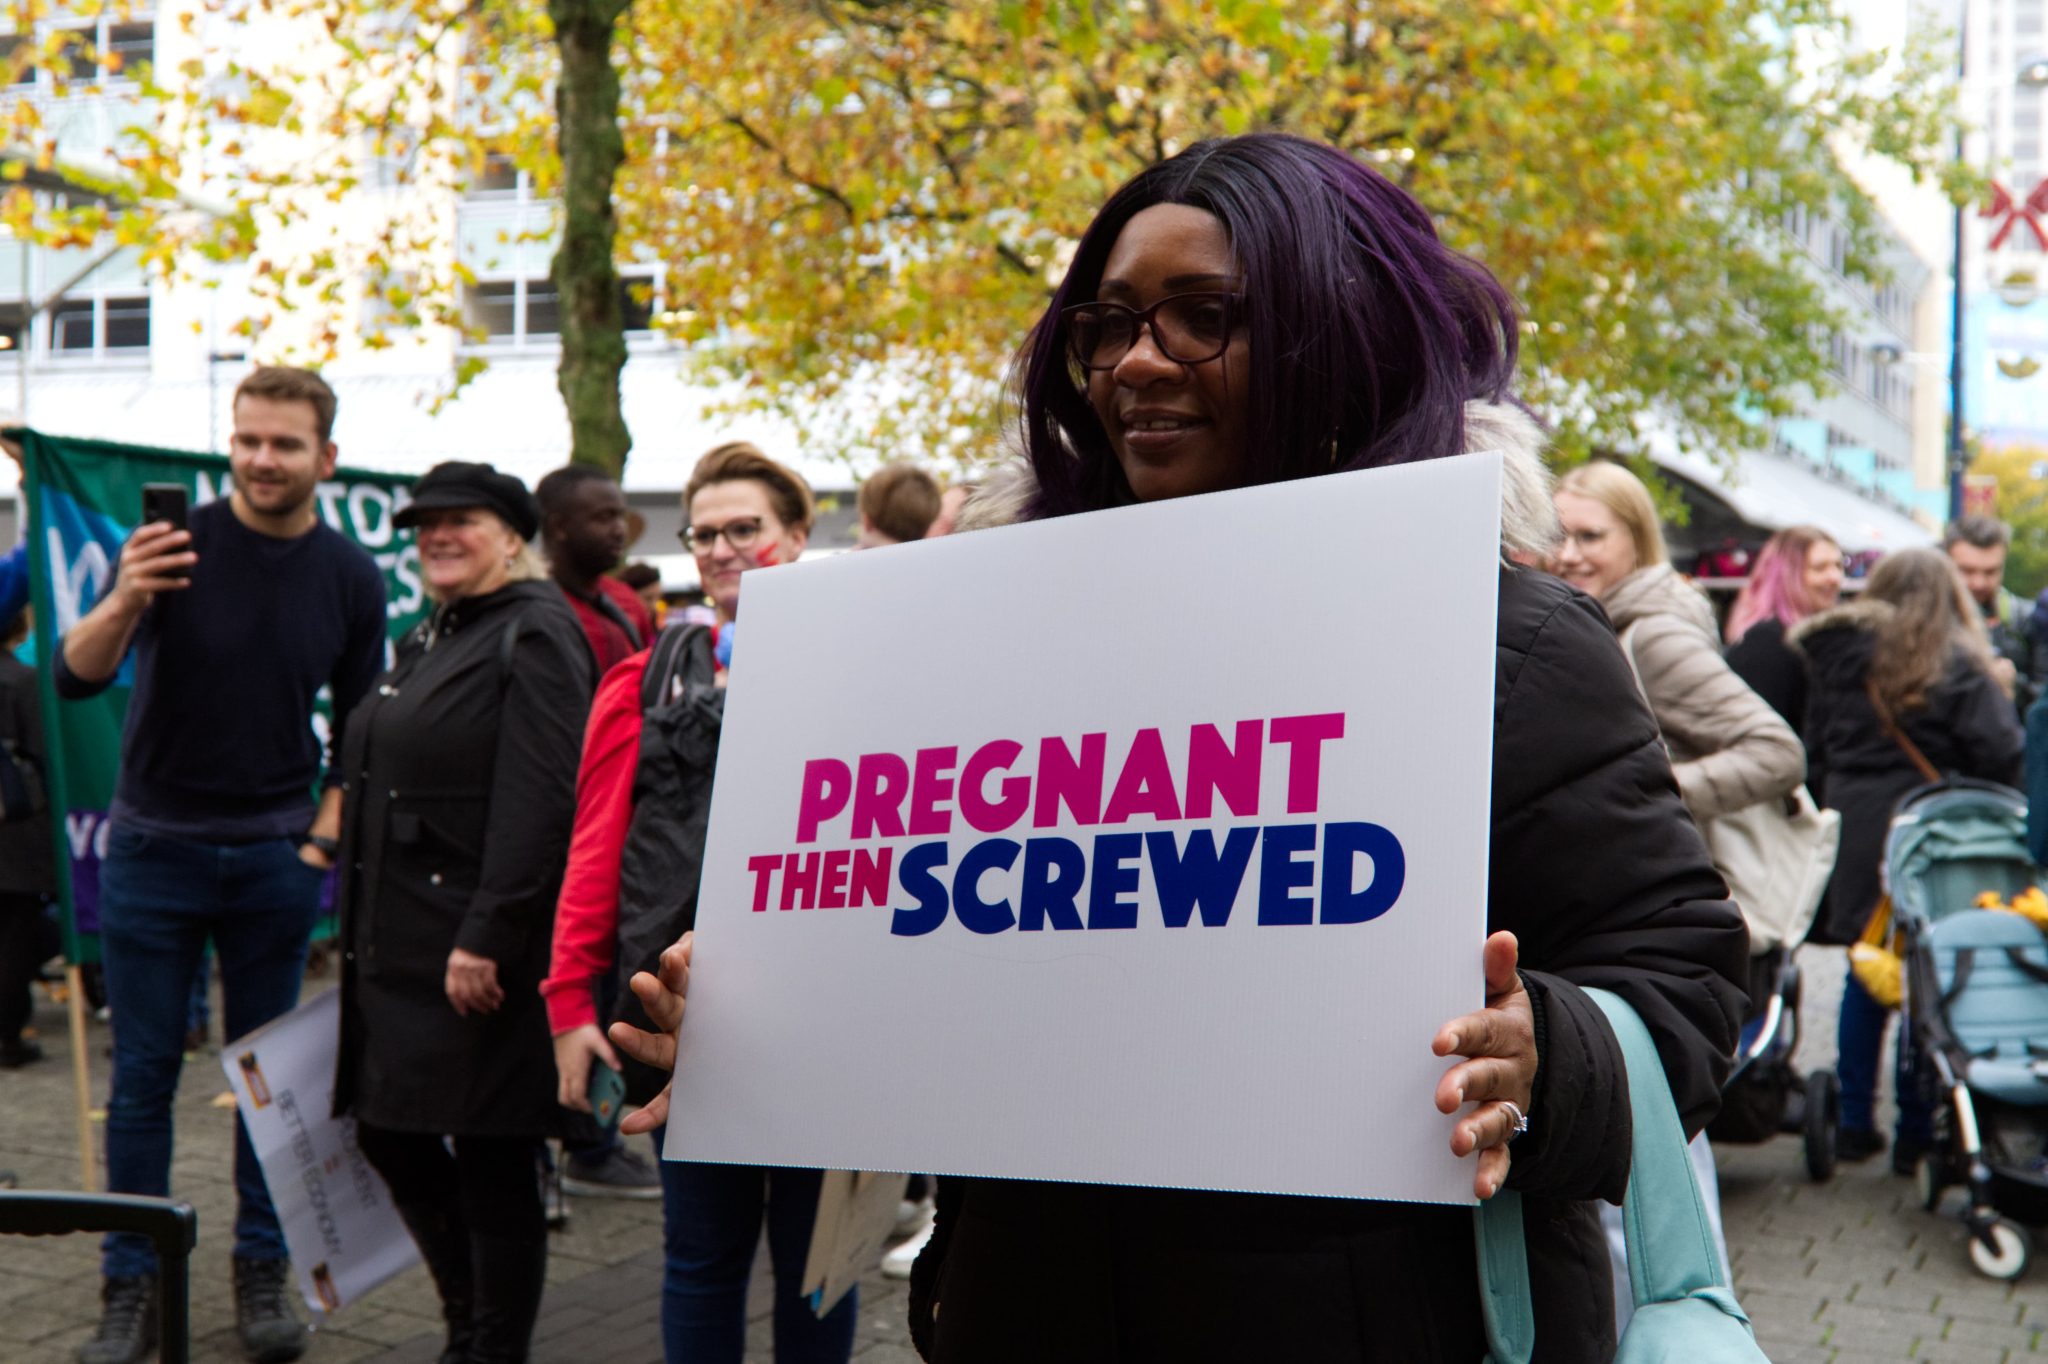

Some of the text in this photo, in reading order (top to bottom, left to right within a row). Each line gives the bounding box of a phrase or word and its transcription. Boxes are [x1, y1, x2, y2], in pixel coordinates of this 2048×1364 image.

[796, 712, 1345, 844] PREGNANT
[747, 822, 1406, 937] THEN SCREWED
[275, 1087, 317, 1168] BETTER
